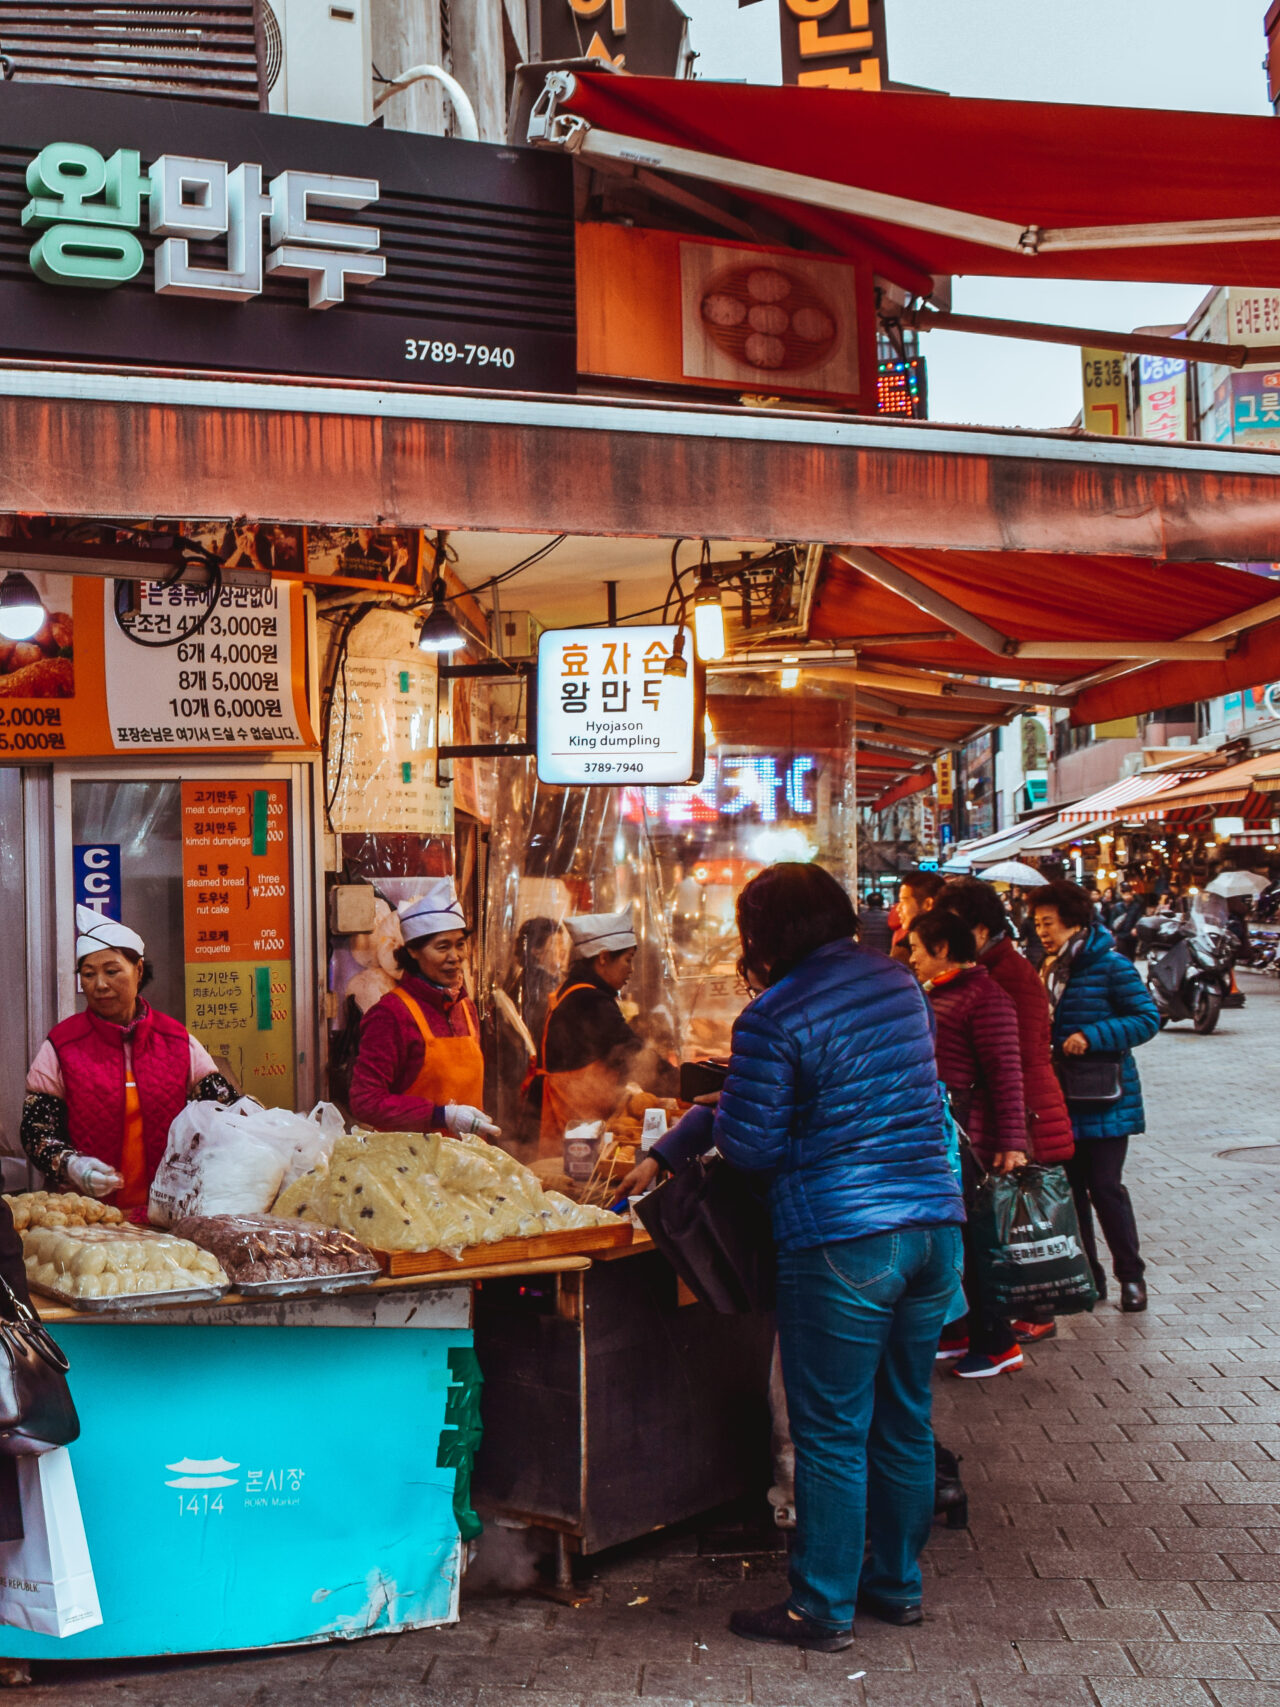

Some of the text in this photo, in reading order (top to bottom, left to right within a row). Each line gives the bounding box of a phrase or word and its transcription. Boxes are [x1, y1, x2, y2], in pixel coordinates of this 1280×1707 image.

[21, 141, 387, 311] 왕만두
[404, 338, 516, 370] 3789-7940
[220, 586, 278, 609] 상관없이
[210, 616, 278, 637] 3,000원
[176, 643, 279, 664] 6개 4,000원
[178, 670, 280, 692] 8개 5,000원
[169, 698, 283, 718] 10개 6,000원
[117, 726, 299, 742] 포장손님은 여기서 드실 수 없습니다.
[586, 720, 643, 734] Hyojason
[569, 735, 661, 748] King dumpling
[584, 762, 644, 773] 3789-7940
[194, 790, 238, 804] 고기만두
[185, 804, 246, 816] meat dumplings
[194, 821, 238, 835] 김치만두
[185, 836, 251, 848] kimchi dumplings
[186, 877, 245, 887] steamed bread
[258, 874, 280, 884] three
[196, 905, 230, 915] nut cake
[260, 929, 277, 938] one
[195, 944, 231, 954] croquette
[196, 971, 240, 984] 고기만두
[196, 1002, 239, 1016] 김치만두
[246, 1468, 306, 1492] 본시장
[177, 1493, 224, 1517] 1414
